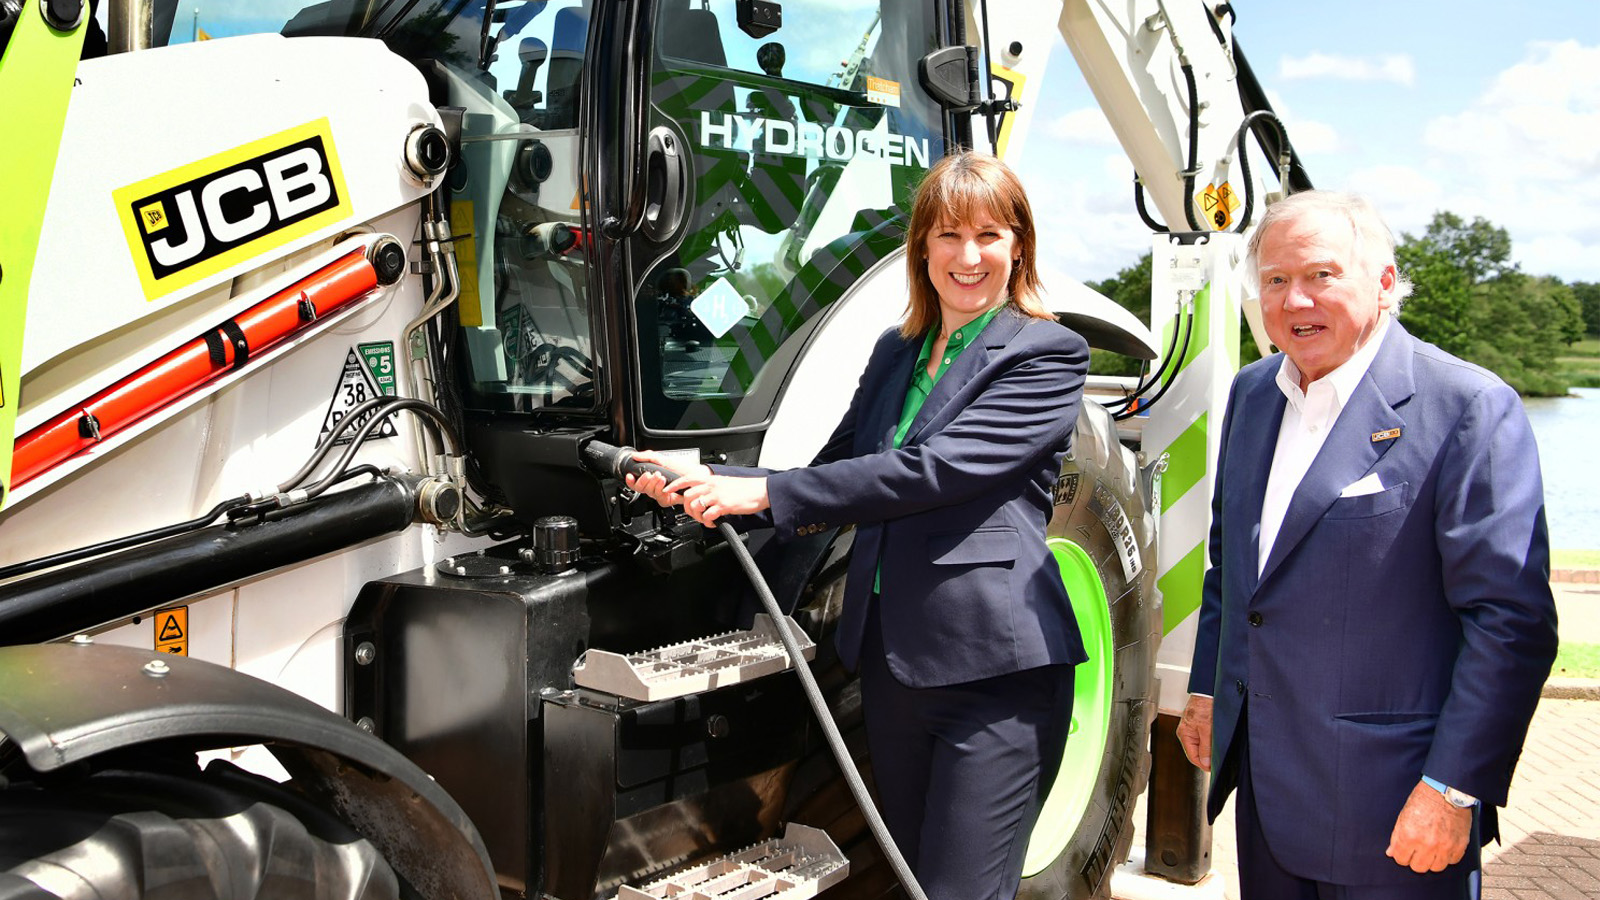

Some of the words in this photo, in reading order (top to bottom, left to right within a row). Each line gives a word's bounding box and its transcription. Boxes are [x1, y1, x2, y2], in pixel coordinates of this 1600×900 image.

[701, 111, 929, 169] HYDROGEN
[148, 210, 163, 225] JCB
[150, 147, 331, 267] JCB
[380, 355, 392, 374] 5
[344, 382, 366, 406] 38
